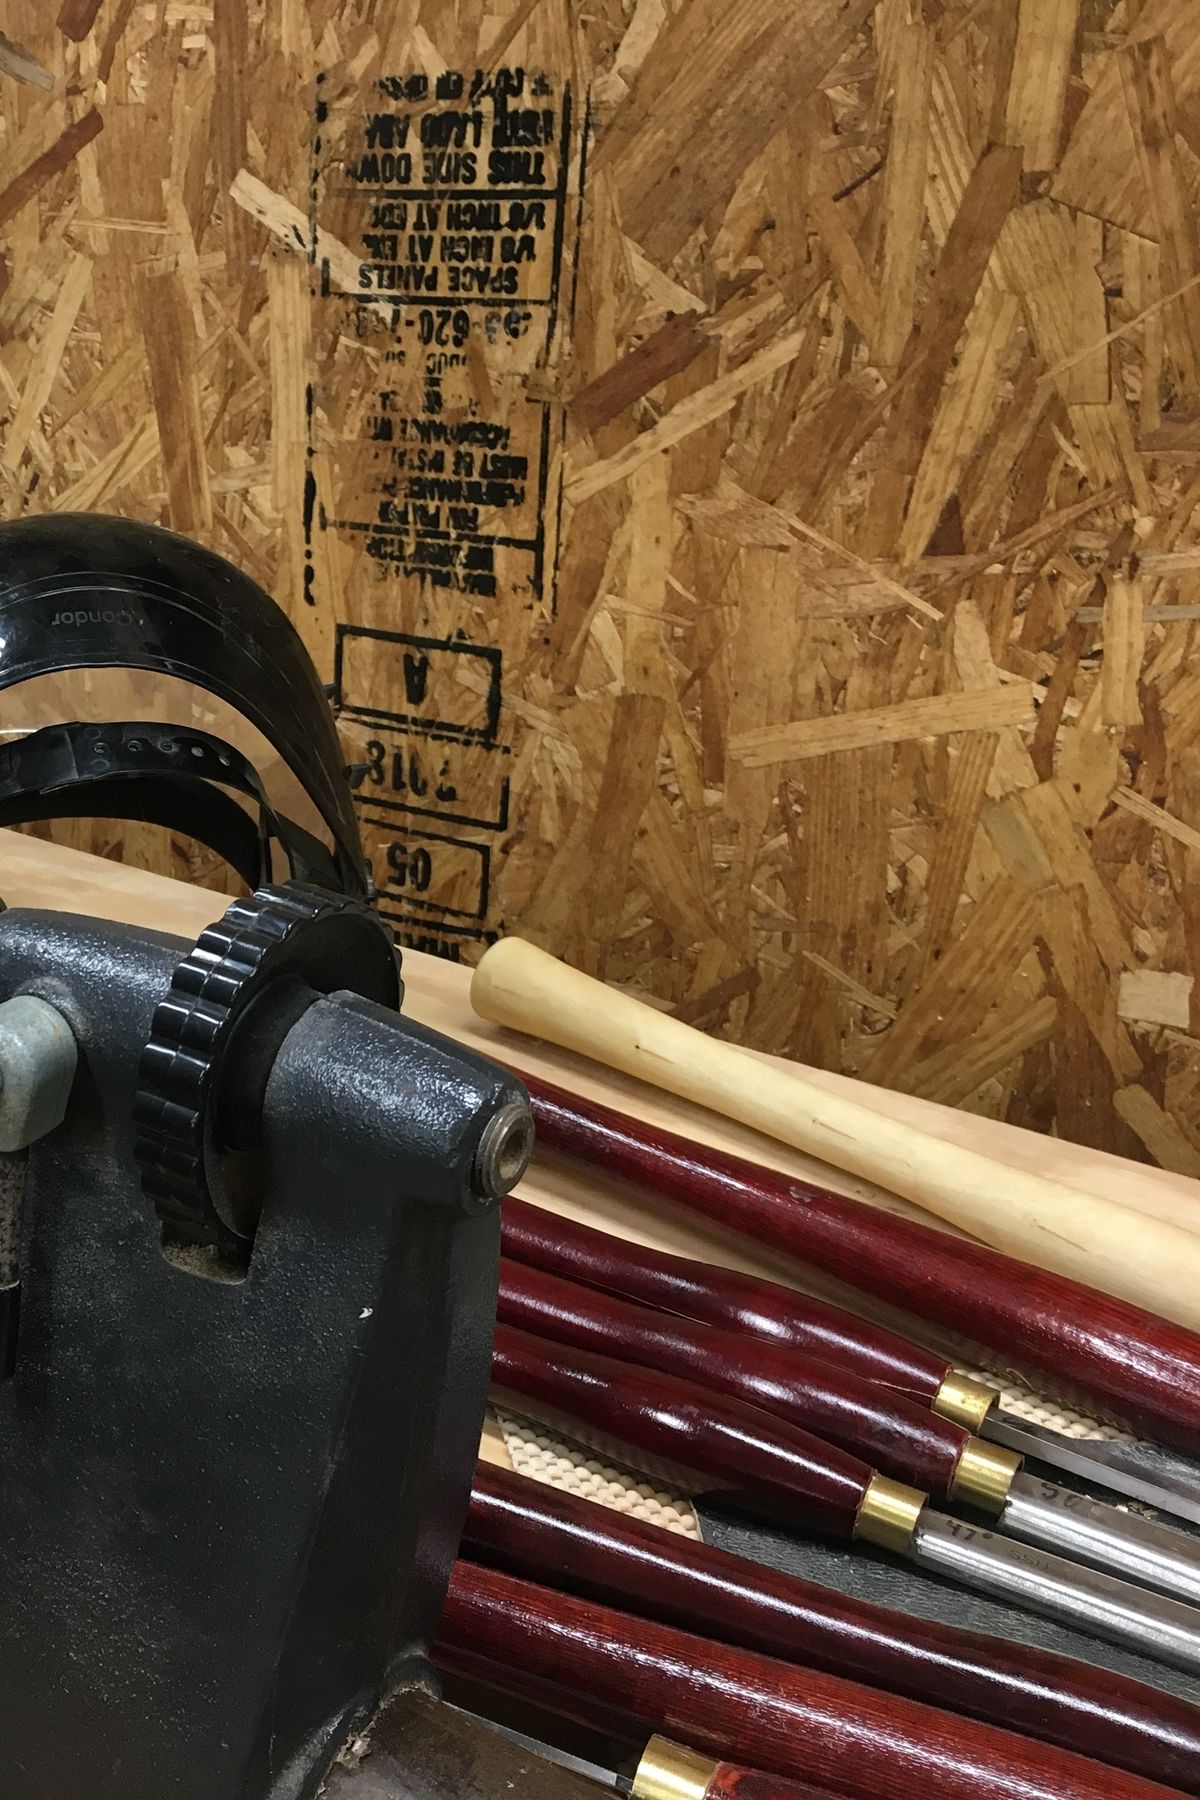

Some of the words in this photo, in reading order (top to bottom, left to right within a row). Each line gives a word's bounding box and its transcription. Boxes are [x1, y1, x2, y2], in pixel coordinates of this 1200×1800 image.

[424, 152, 477, 184] SIDE
[488, 151, 545, 184] THIS
[412, 203, 440, 230] AT
[405, 234, 433, 261] AT
[358, 264, 438, 291] PANELS
[448, 266, 518, 294] SPACE
[51, 609, 133, 627] Condor
[402, 654, 428, 706] A
[386, 842, 432, 893] 05
